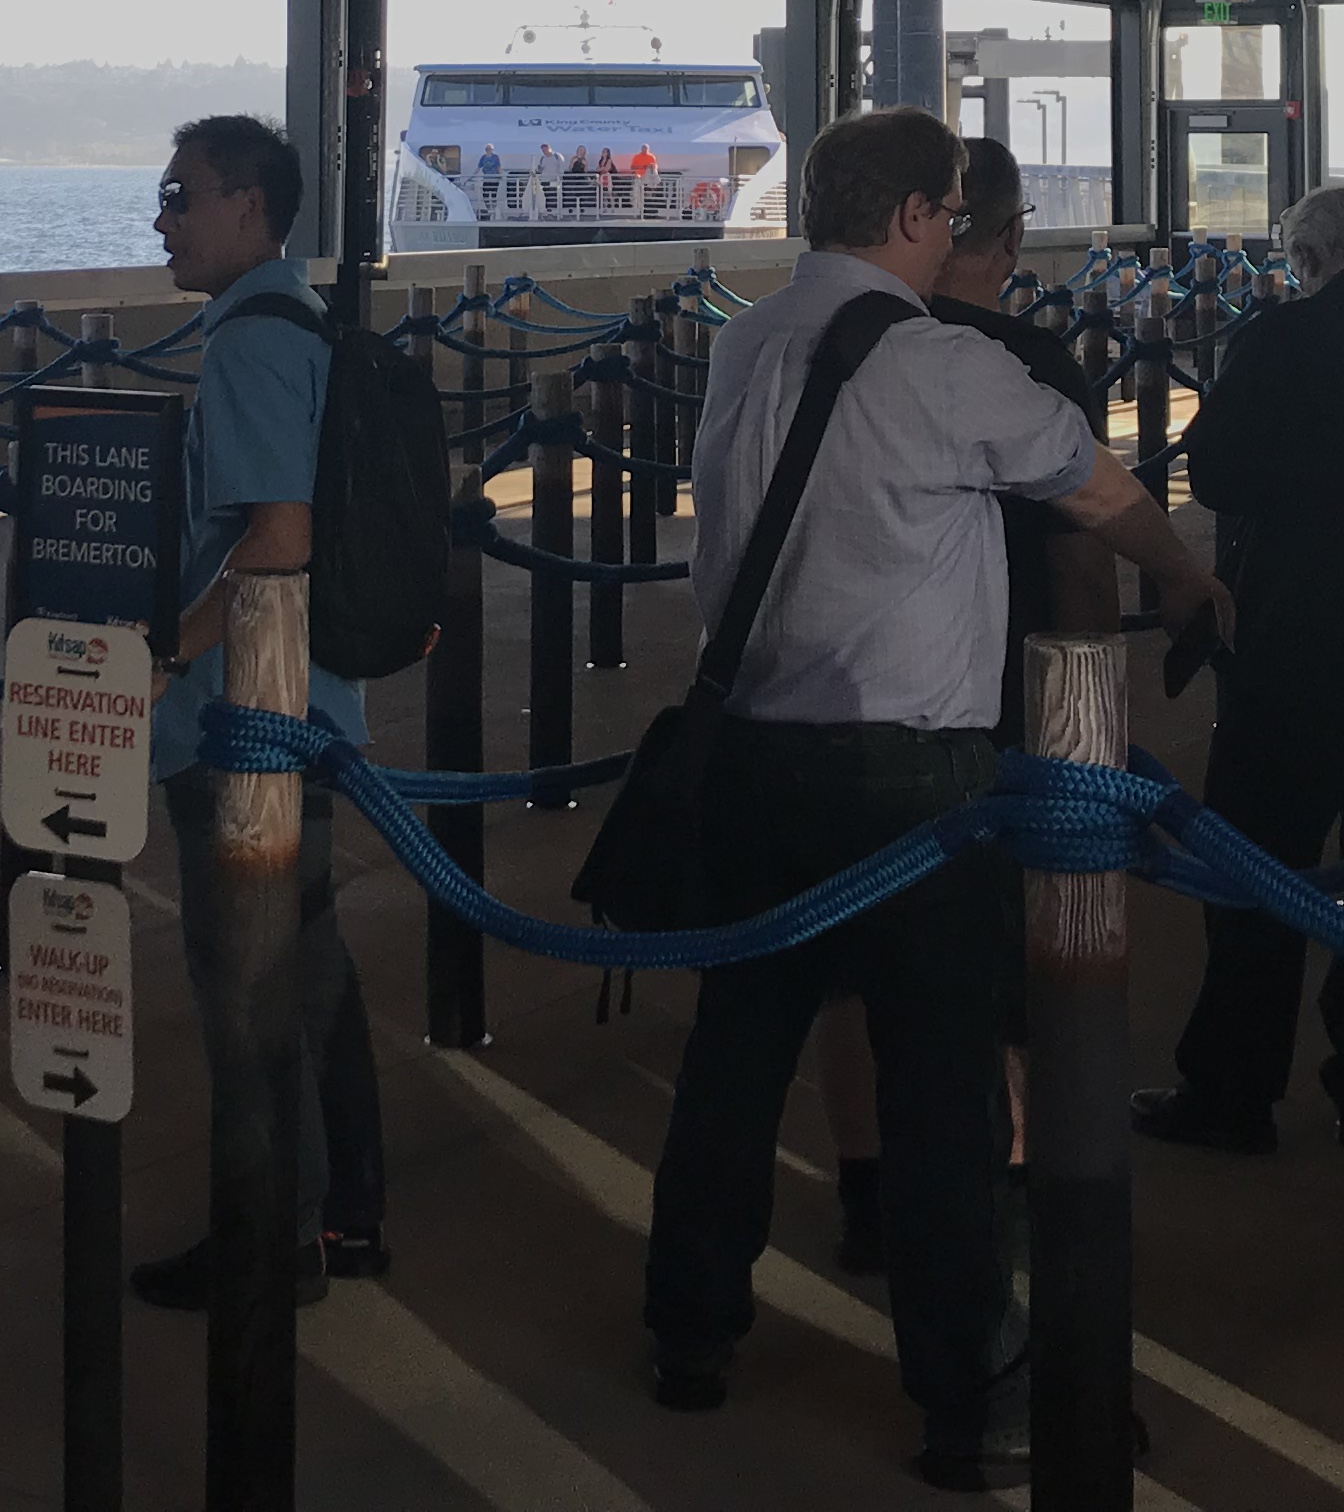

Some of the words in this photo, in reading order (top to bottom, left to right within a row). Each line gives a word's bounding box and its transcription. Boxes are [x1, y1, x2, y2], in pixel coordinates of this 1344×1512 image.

[1204, 2, 1230, 21] EXIT
[546, 125, 622, 133] Water
[624, 125, 673, 134] Taxi
[44, 442, 90, 467] THIS
[95, 444, 150, 470] LANE
[40, 474, 152, 503] BOARDING
[75, 508, 117, 533] FOR
[32, 537, 156, 569] BREMERTON
[9, 681, 145, 719] RESERVATION
[17, 714, 61, 740] LINE
[69, 720, 136, 749] ENTER
[48, 748, 102, 778] HERE
[30, 944, 109, 978] WALK-UP
[18, 997, 72, 1028] ENTER
[78, 1008, 123, 1038] HERE
